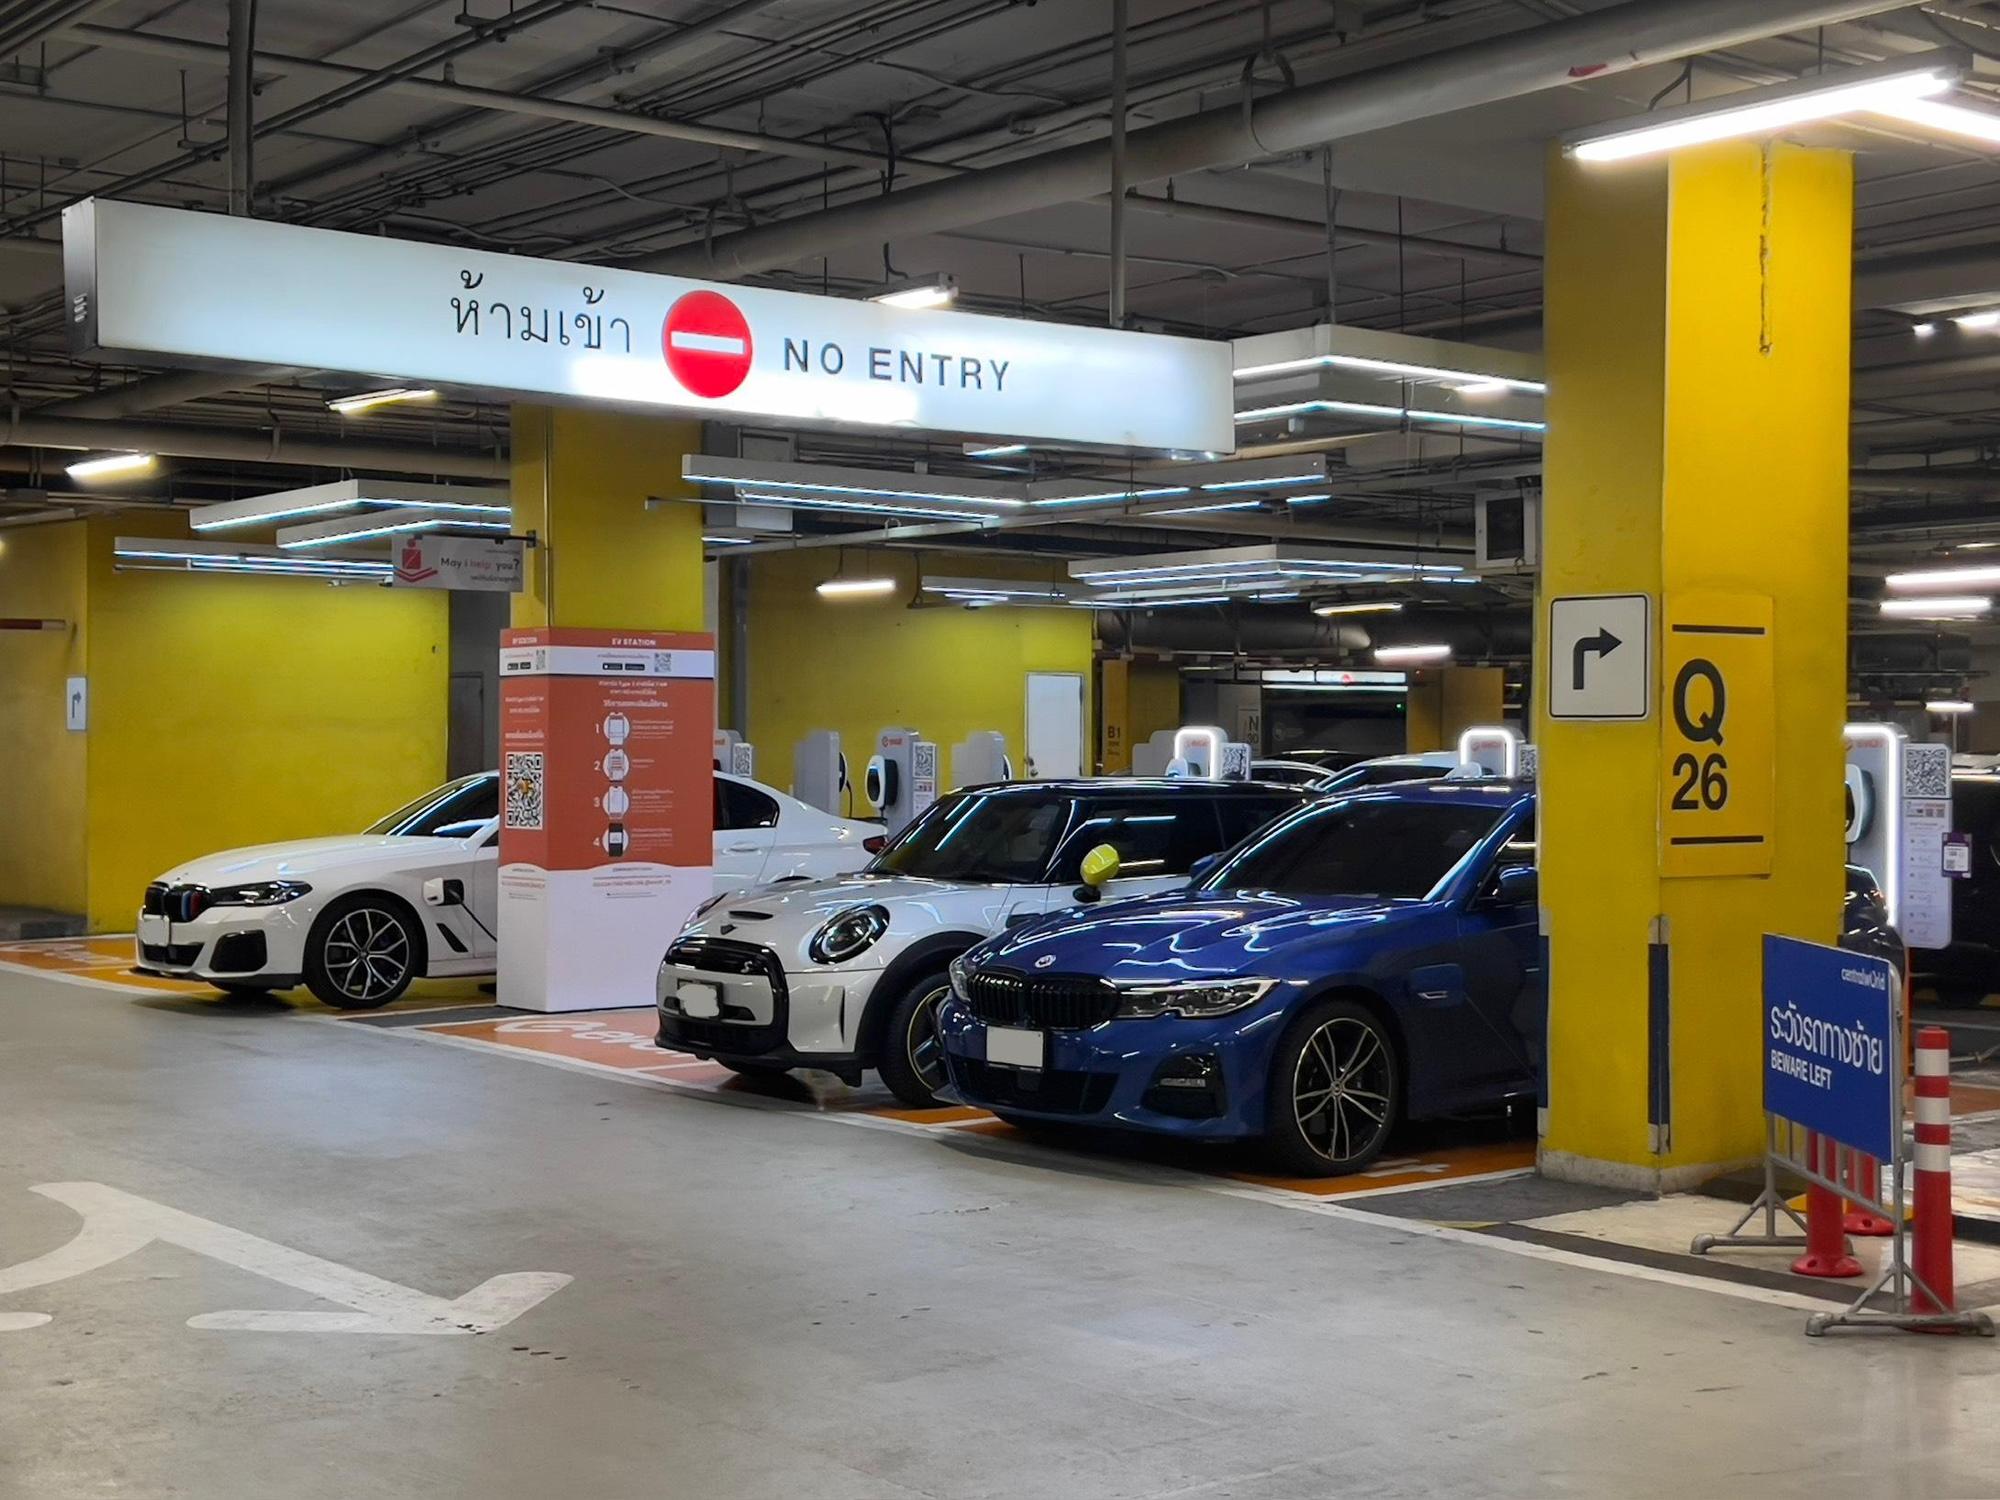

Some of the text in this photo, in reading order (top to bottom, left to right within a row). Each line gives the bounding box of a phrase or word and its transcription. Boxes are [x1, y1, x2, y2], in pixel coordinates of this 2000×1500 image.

[451, 269, 631, 353] ห้ามเข้า
[783, 337, 1010, 392] NO ENTRY
[440, 557, 463, 569] May
[623, 638, 657, 647] STATION
[1672, 658, 1726, 747] Q
[1248, 715, 1259, 732] N
[594, 760, 601, 771] 2
[1671, 752, 1728, 811] 26
[1770, 1049, 1833, 1090] BEWARE LEFT
